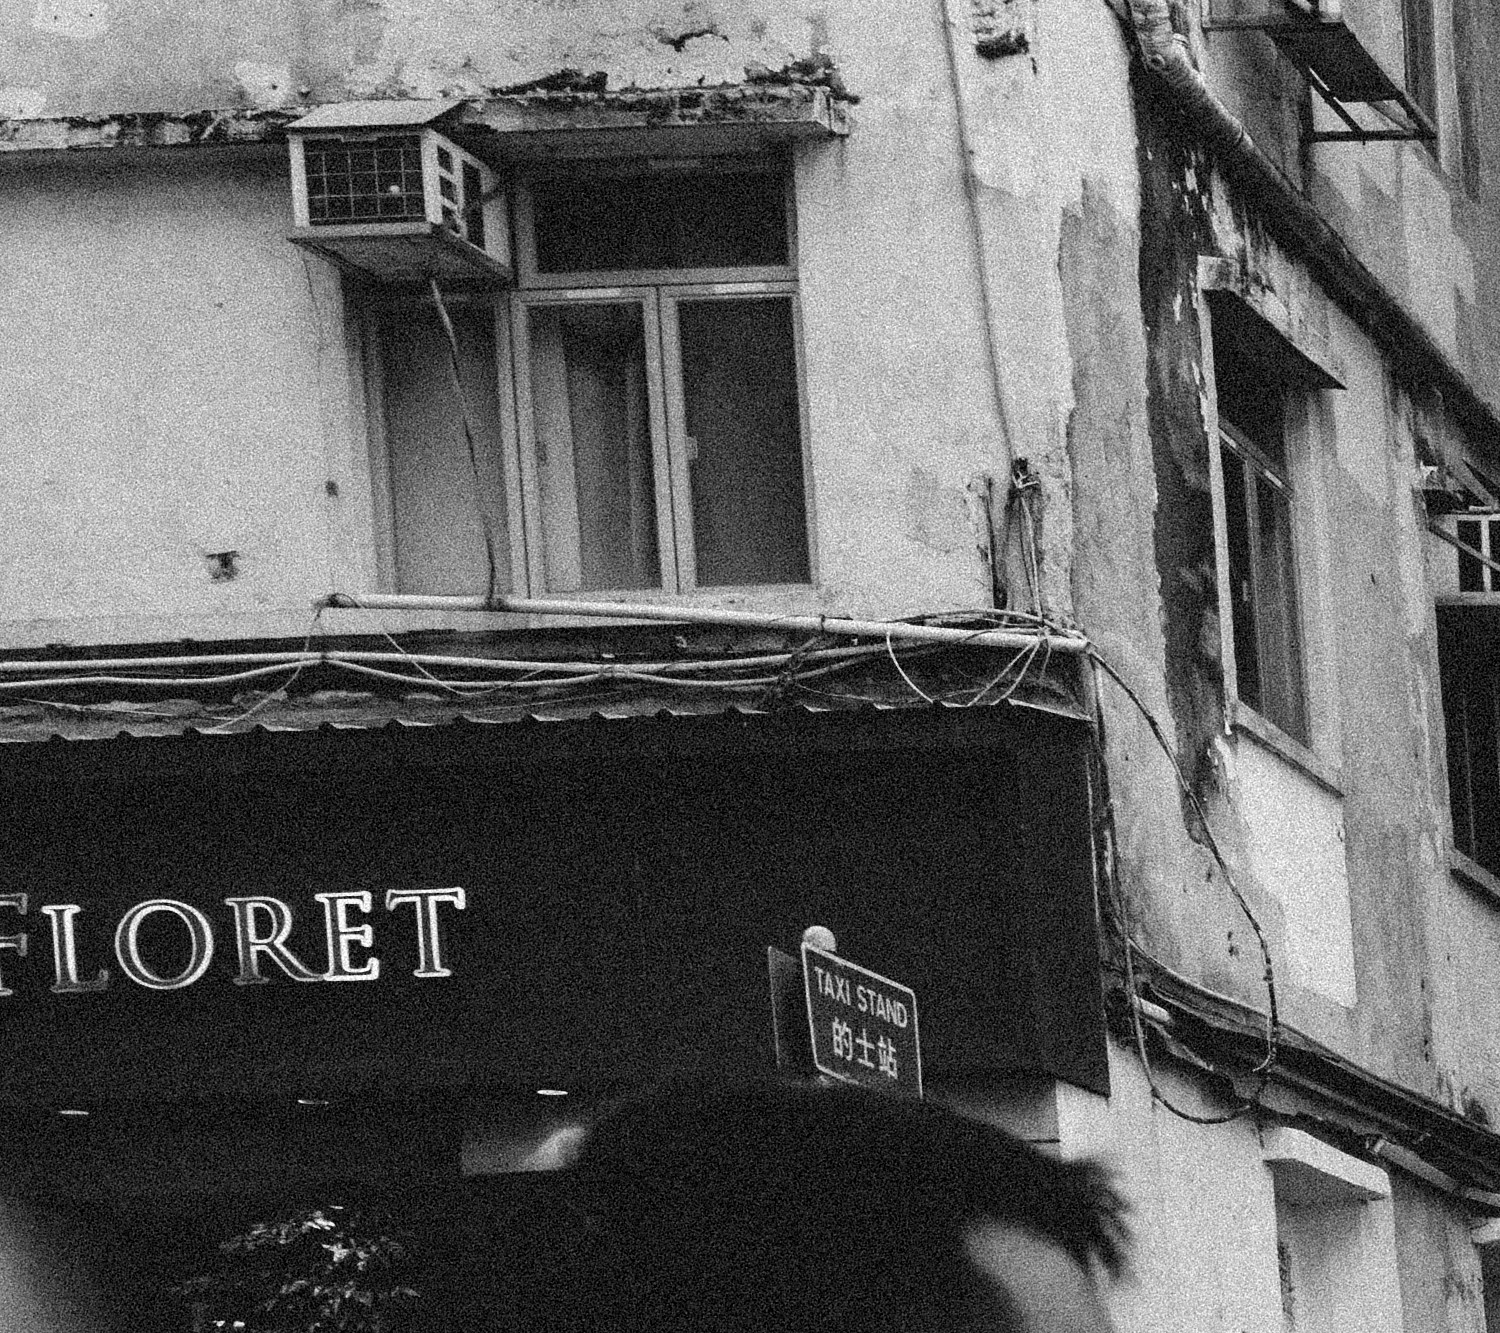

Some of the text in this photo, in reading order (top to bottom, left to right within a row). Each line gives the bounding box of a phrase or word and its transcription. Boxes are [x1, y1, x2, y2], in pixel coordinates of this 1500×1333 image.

[813, 966, 909, 1029] TAXI STAND
[830, 1015, 899, 1080] 的士站
